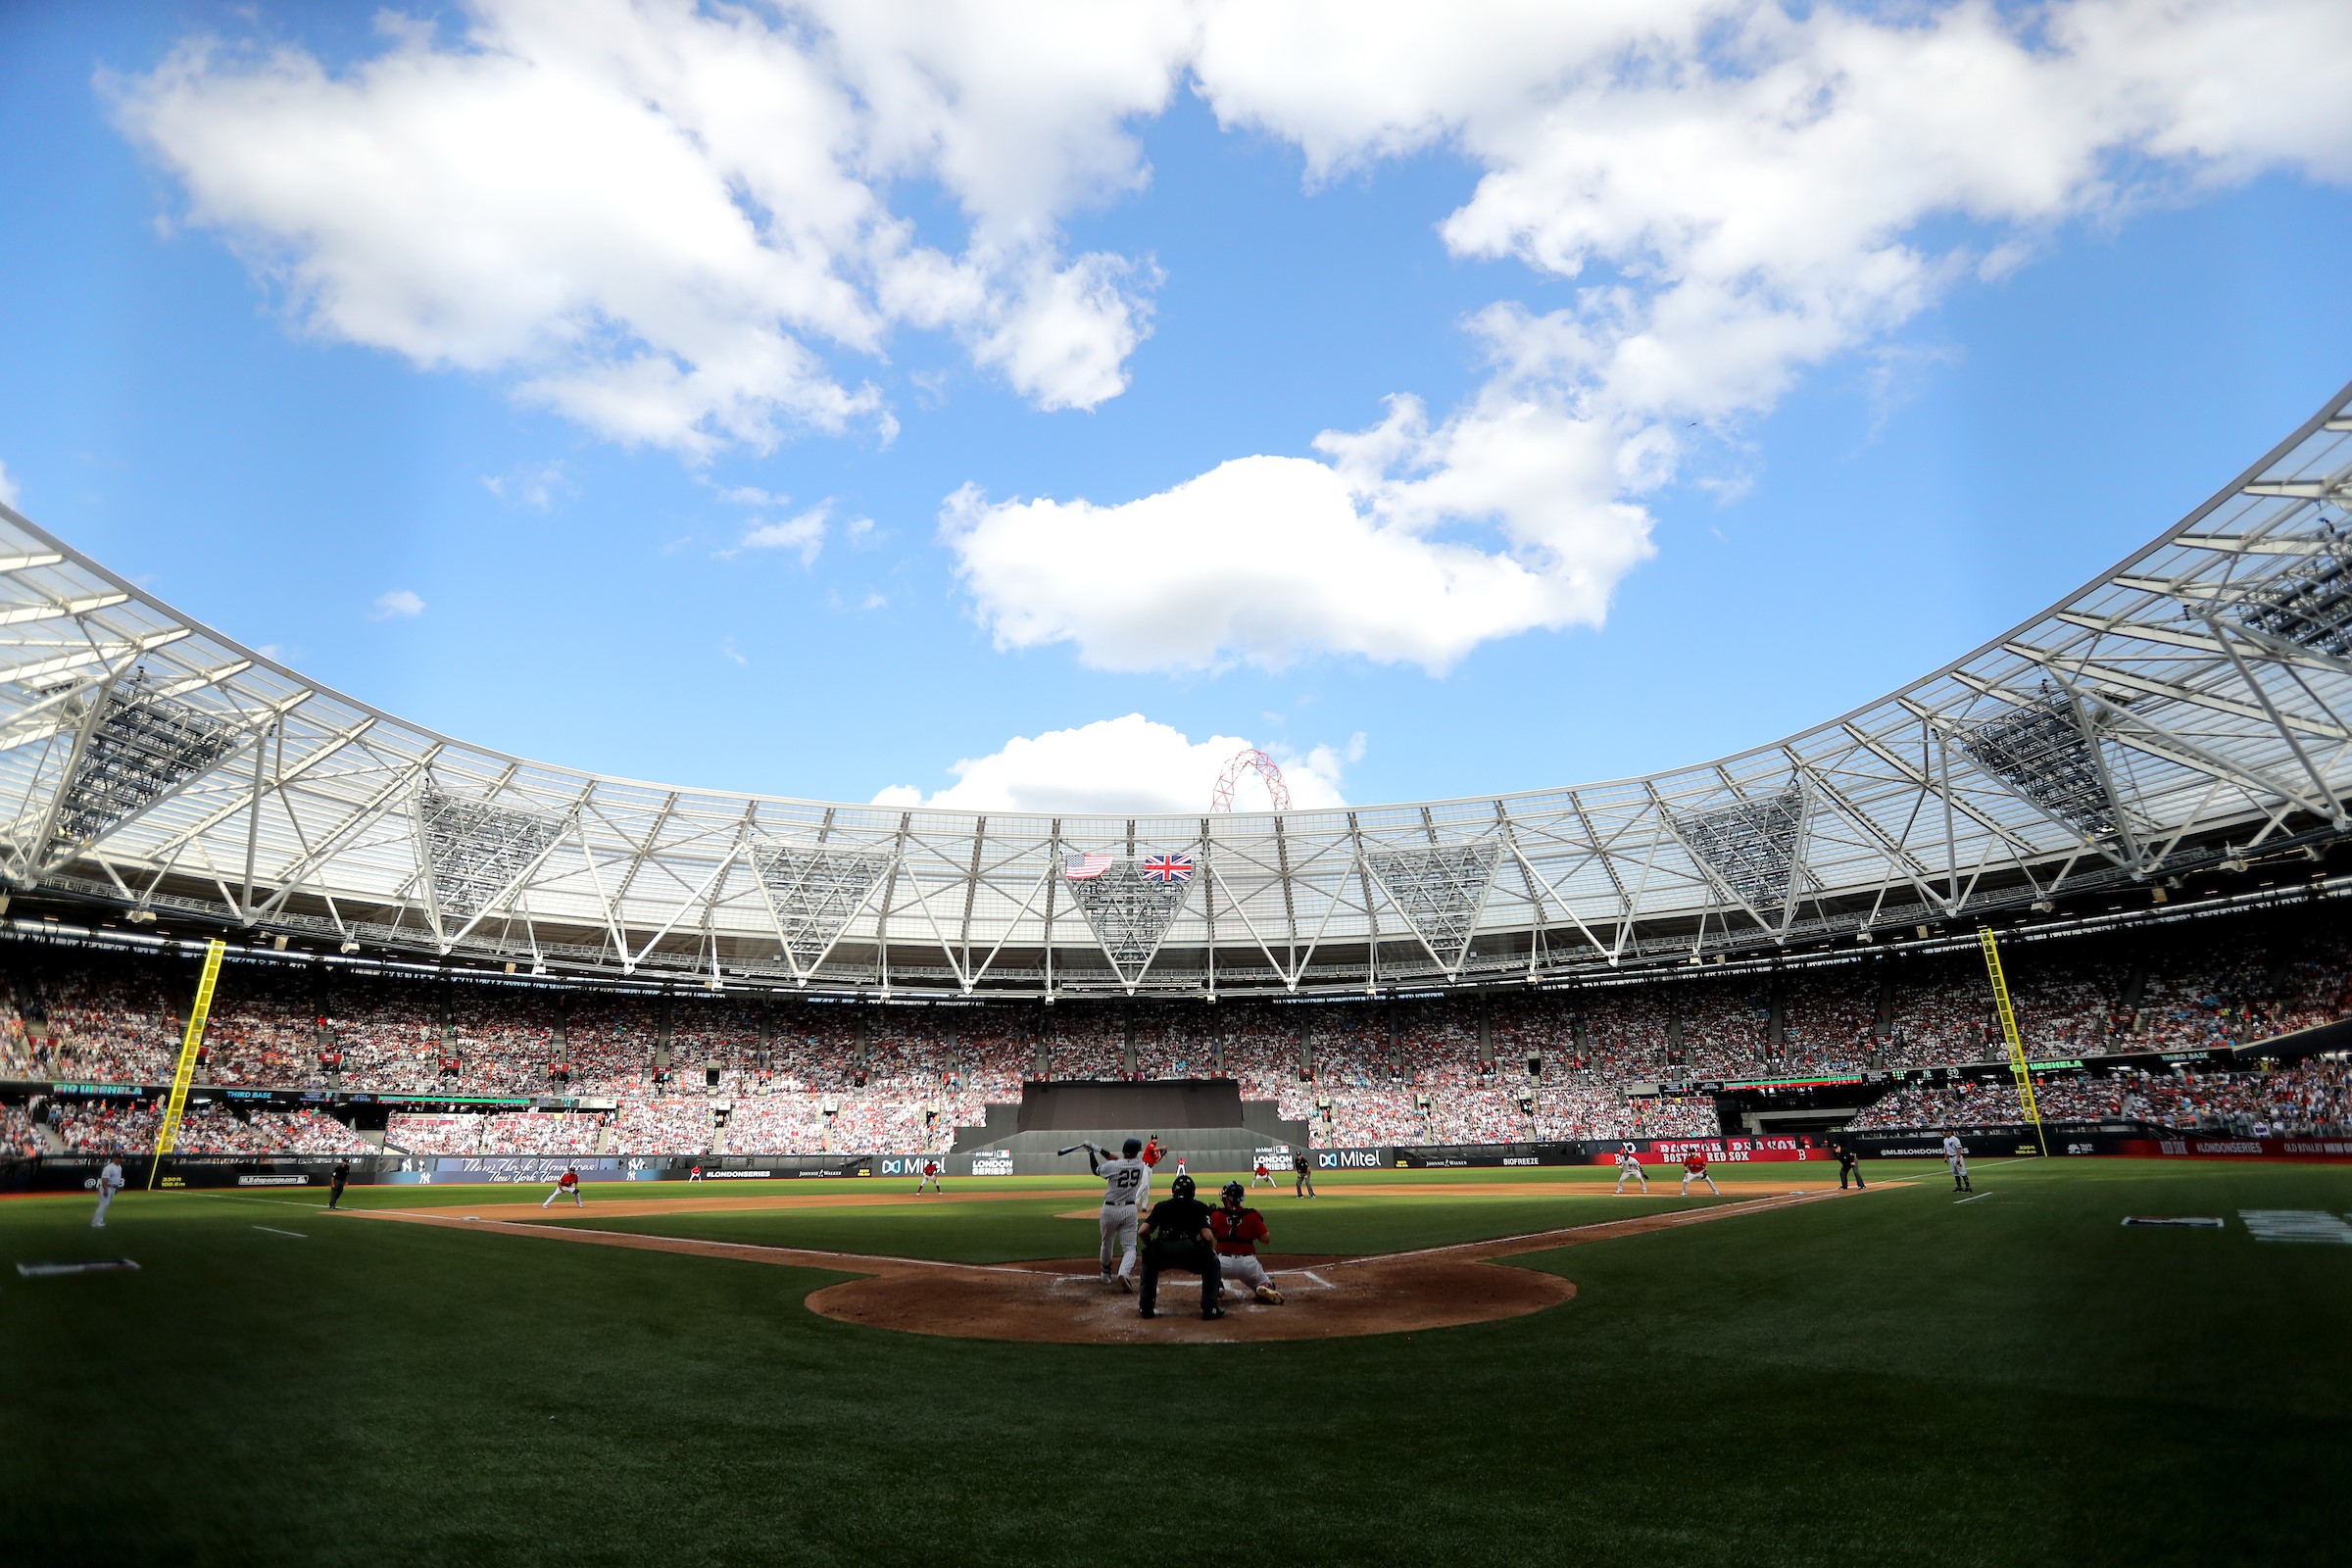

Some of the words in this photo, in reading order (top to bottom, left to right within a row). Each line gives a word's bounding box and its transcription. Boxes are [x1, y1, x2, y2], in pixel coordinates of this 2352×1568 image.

[2030, 1060, 2083, 1071] URSHELA
[2196, 1143, 2263, 1153] #LONDONSERIES
[2284, 1144, 2298, 1152] OLD
[1341, 1151, 1382, 1166] Mitel
[1706, 1152, 1726, 1162] RED
[1729, 1152, 1749, 1161] SOX
[1797, 1150, 1806, 1160] B
[489, 1171, 511, 1182] New
[513, 1171, 536, 1184] York
[1117, 1169, 1141, 1188] 29
